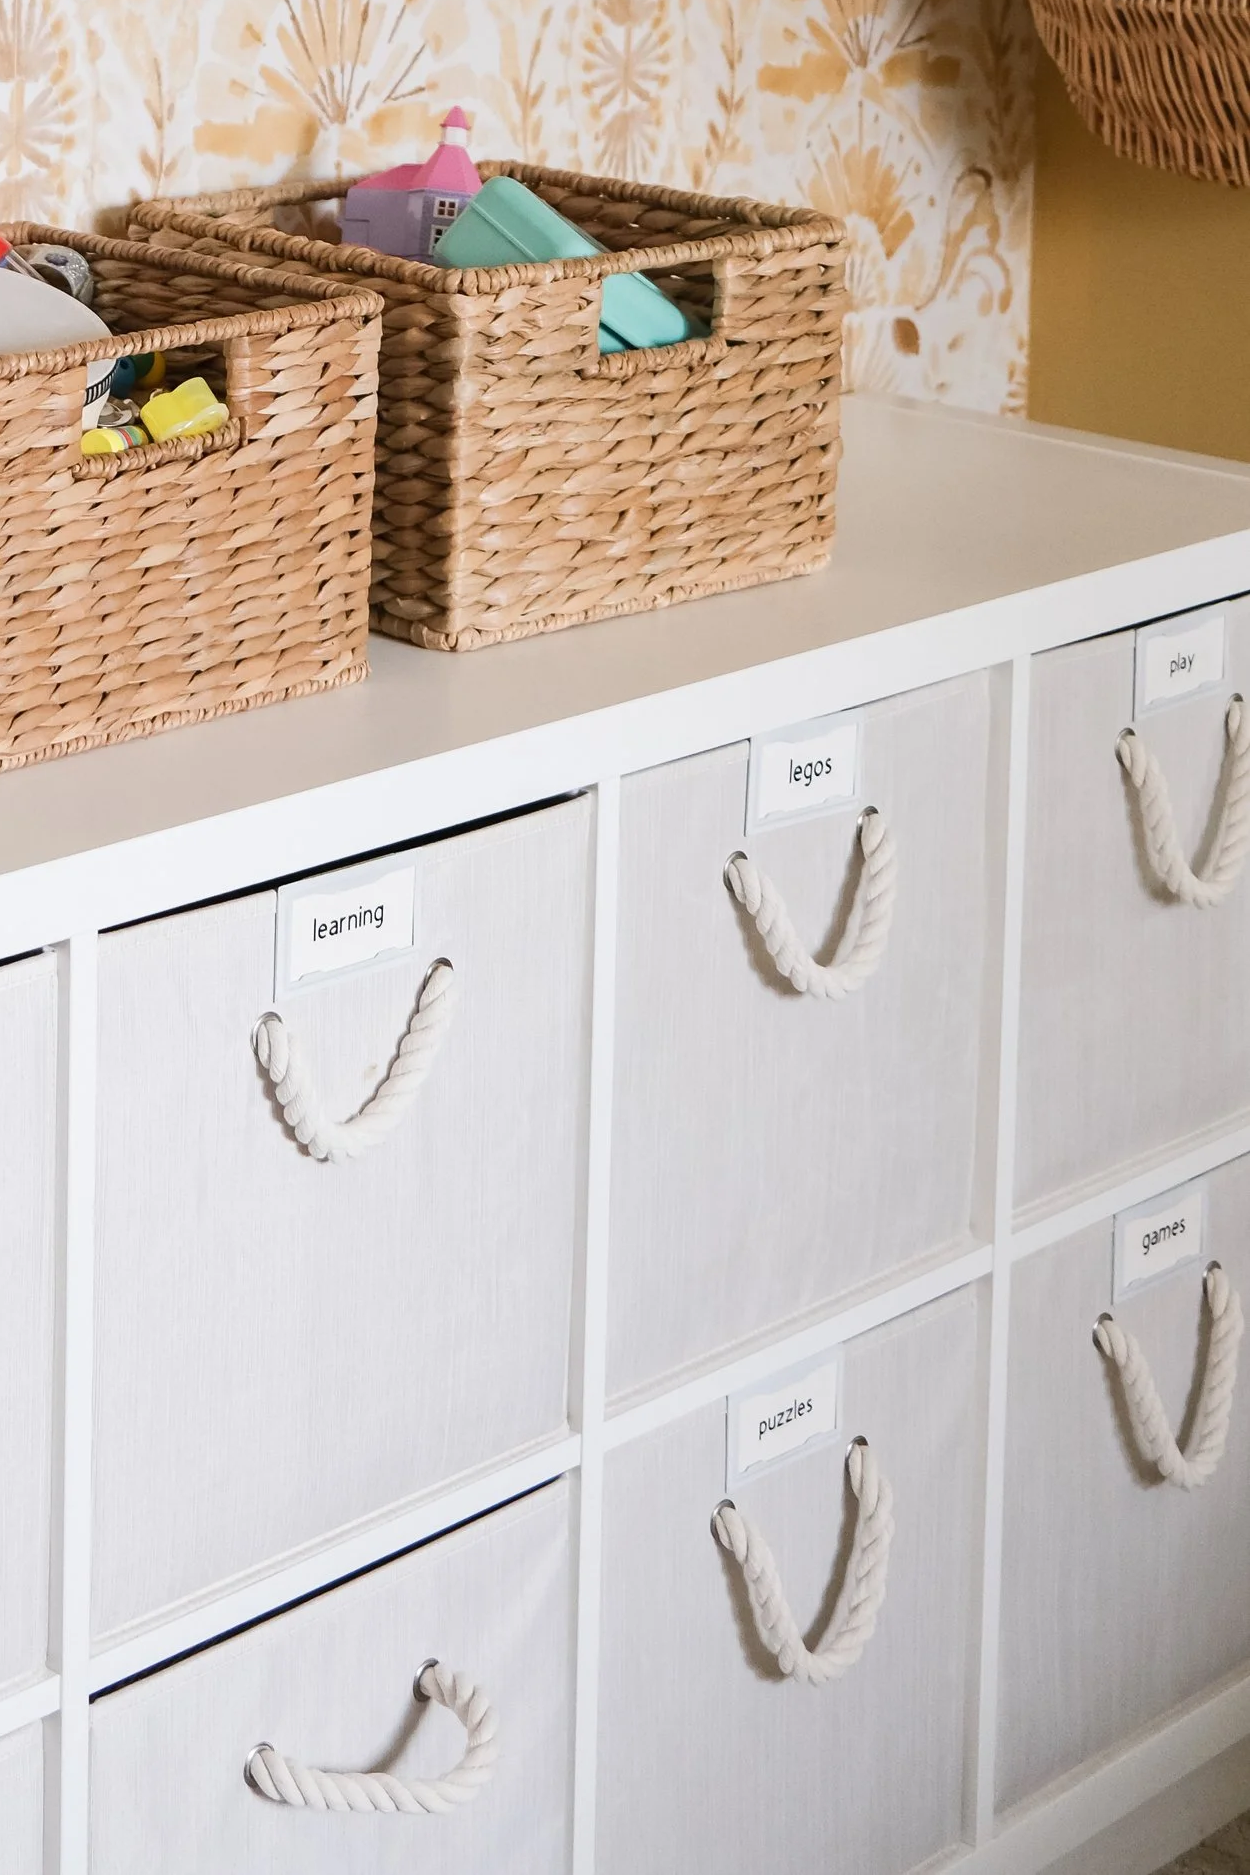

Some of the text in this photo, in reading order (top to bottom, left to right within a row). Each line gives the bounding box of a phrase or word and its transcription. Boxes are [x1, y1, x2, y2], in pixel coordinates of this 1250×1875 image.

[1169, 652, 1195, 677] play
[789, 757, 832, 787] legos
[312, 905, 384, 942] learning
[1142, 1218, 1186, 1255] games
[758, 1398, 813, 1440] puzzles
